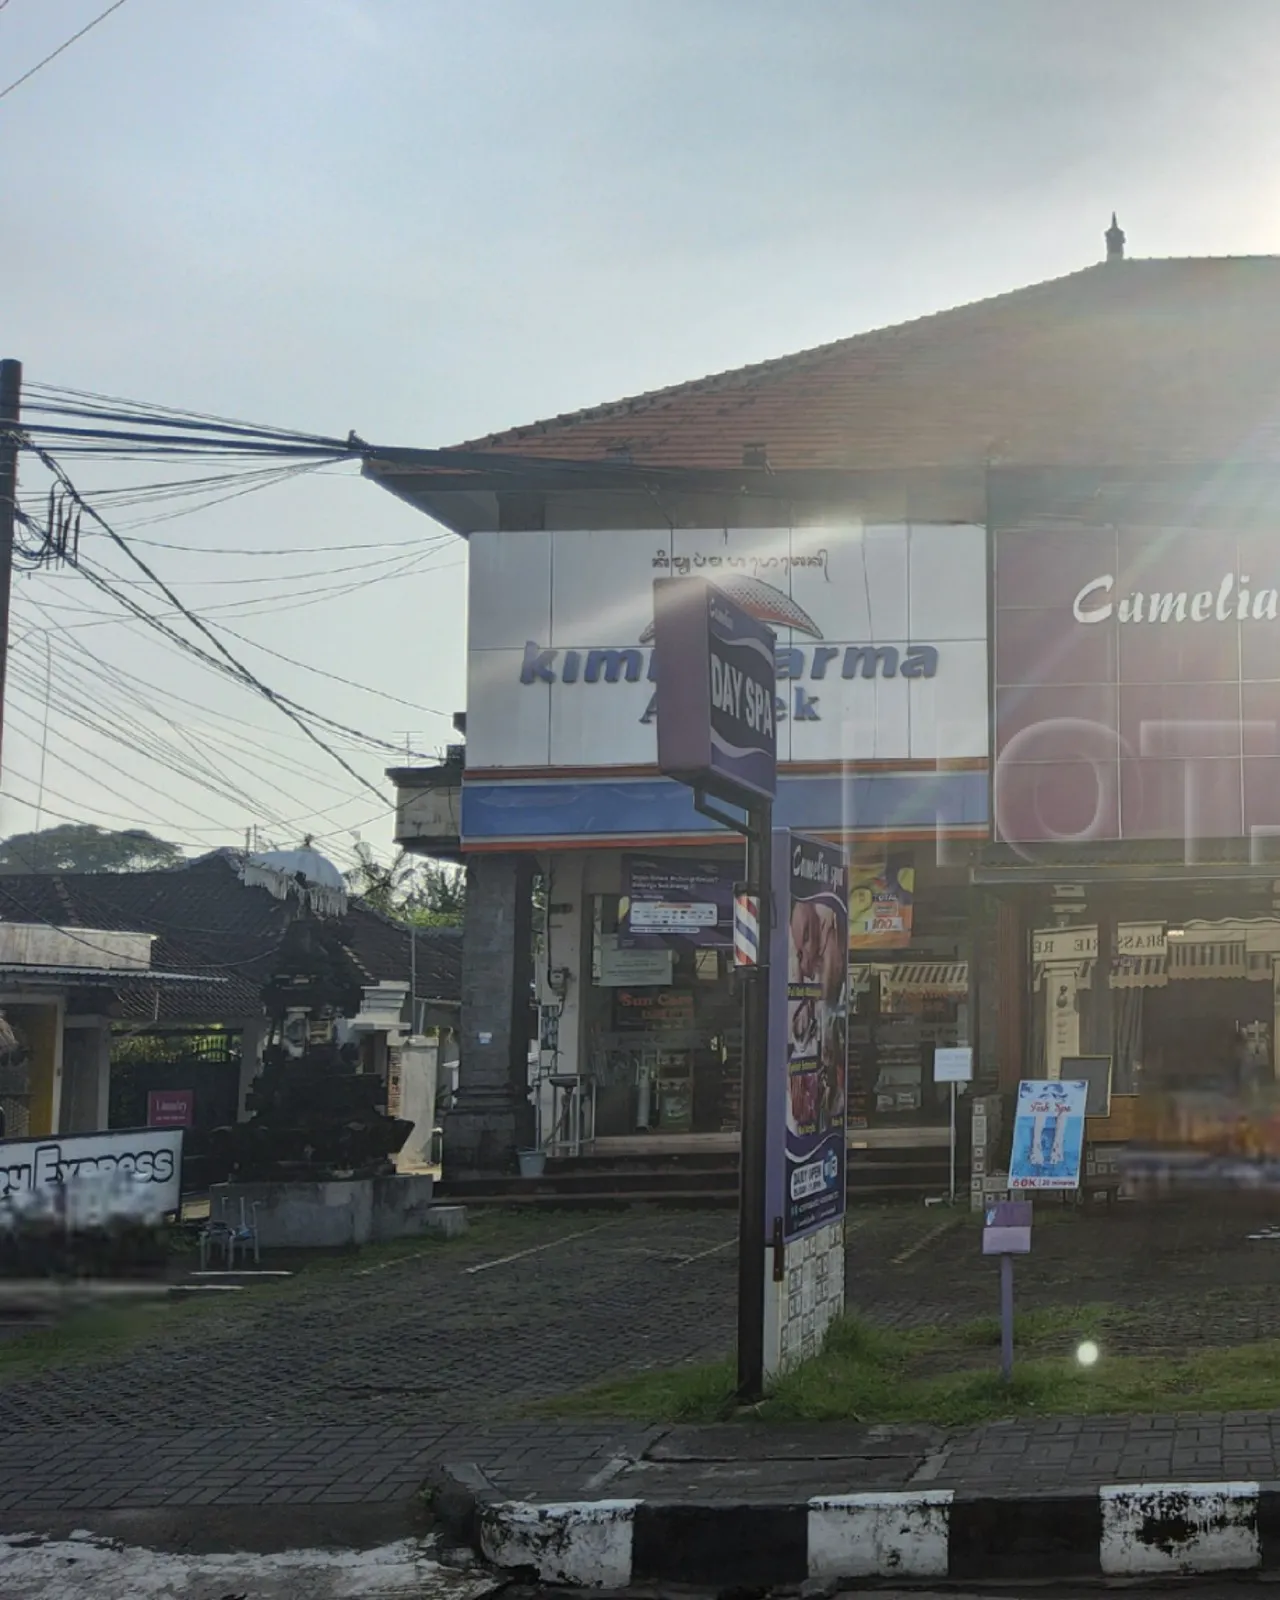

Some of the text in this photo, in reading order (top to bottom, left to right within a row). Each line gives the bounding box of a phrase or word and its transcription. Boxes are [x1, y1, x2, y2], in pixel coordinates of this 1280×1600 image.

[1073, 572, 1279, 623] Camelia
[774, 645, 939, 681] arma
[710, 653, 774, 740] DAY SPA
